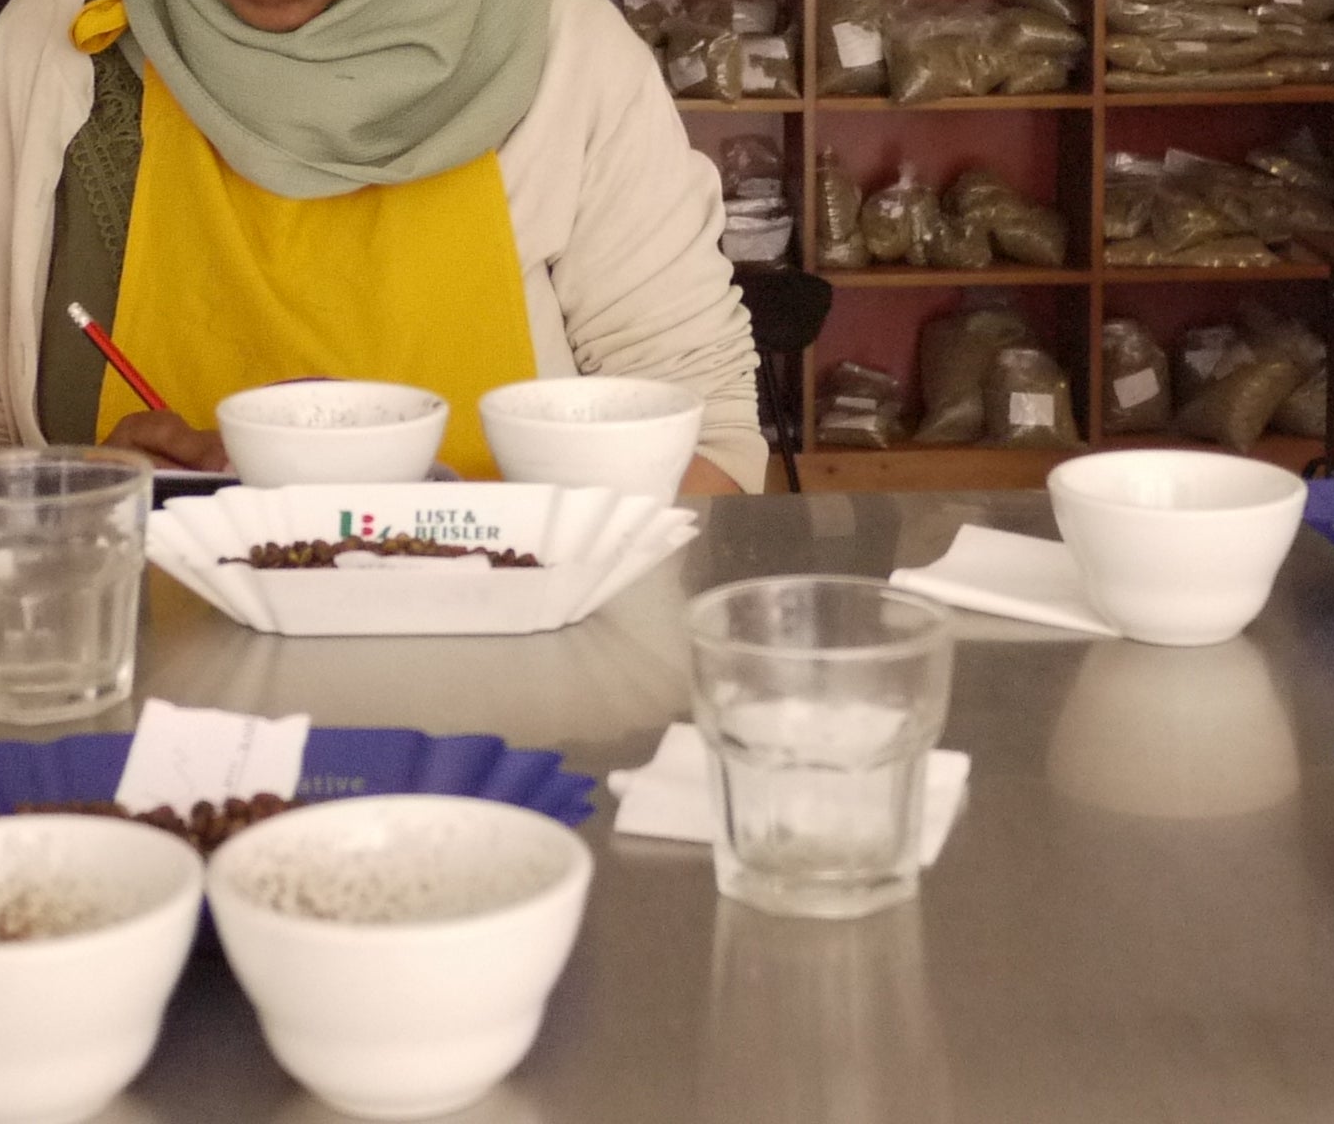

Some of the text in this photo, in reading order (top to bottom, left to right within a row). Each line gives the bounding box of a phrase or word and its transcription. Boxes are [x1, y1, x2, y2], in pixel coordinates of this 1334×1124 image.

[416, 510, 476, 524] LIST &
[415, 526, 500, 540] BEISLER
[300, 775, 365, 794] ative
